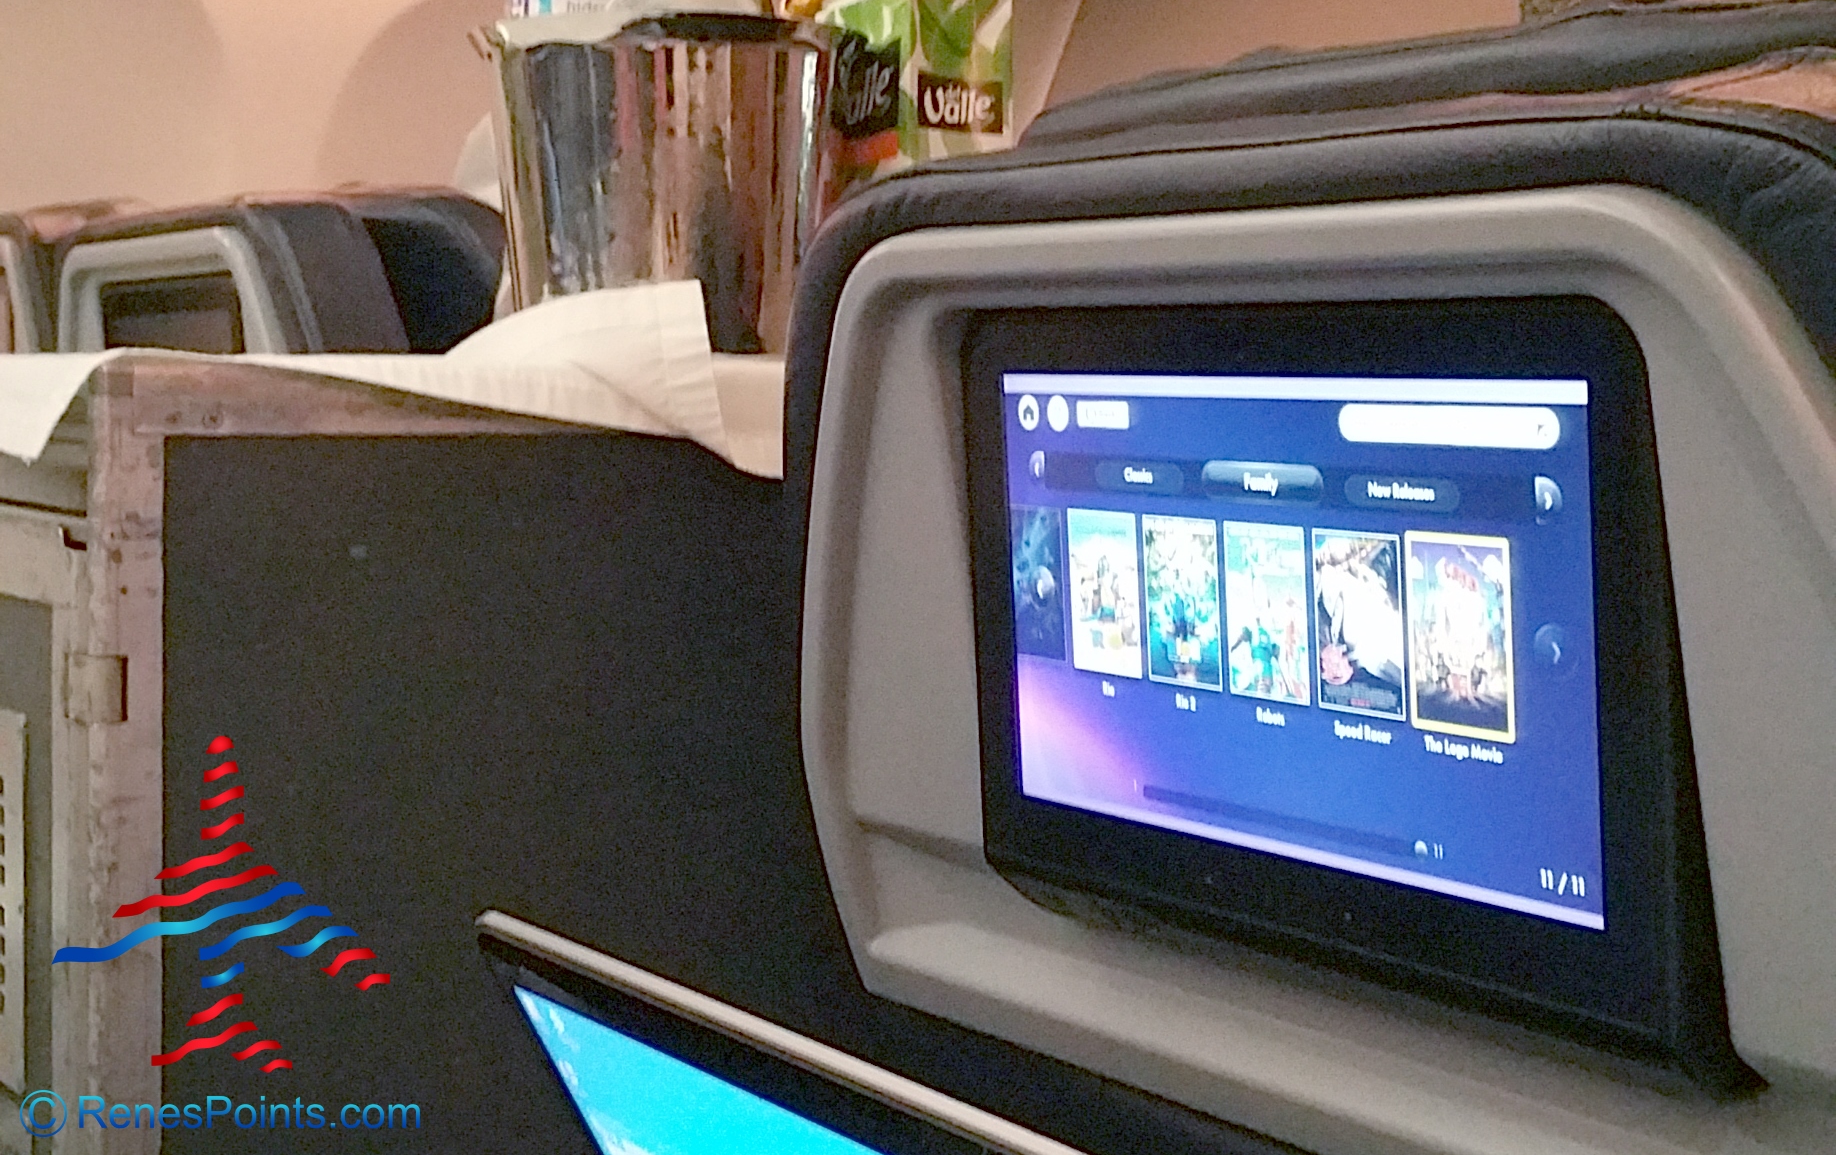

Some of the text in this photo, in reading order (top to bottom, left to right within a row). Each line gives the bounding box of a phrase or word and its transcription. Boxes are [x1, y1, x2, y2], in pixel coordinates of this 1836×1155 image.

[924, 84, 993, 124] Valle
[1243, 471, 1279, 497] Family
[1367, 481, 1392, 498] New
[1334, 720, 1392, 745] Speed Racer
[1423, 734, 1504, 765] The Lego Movie
